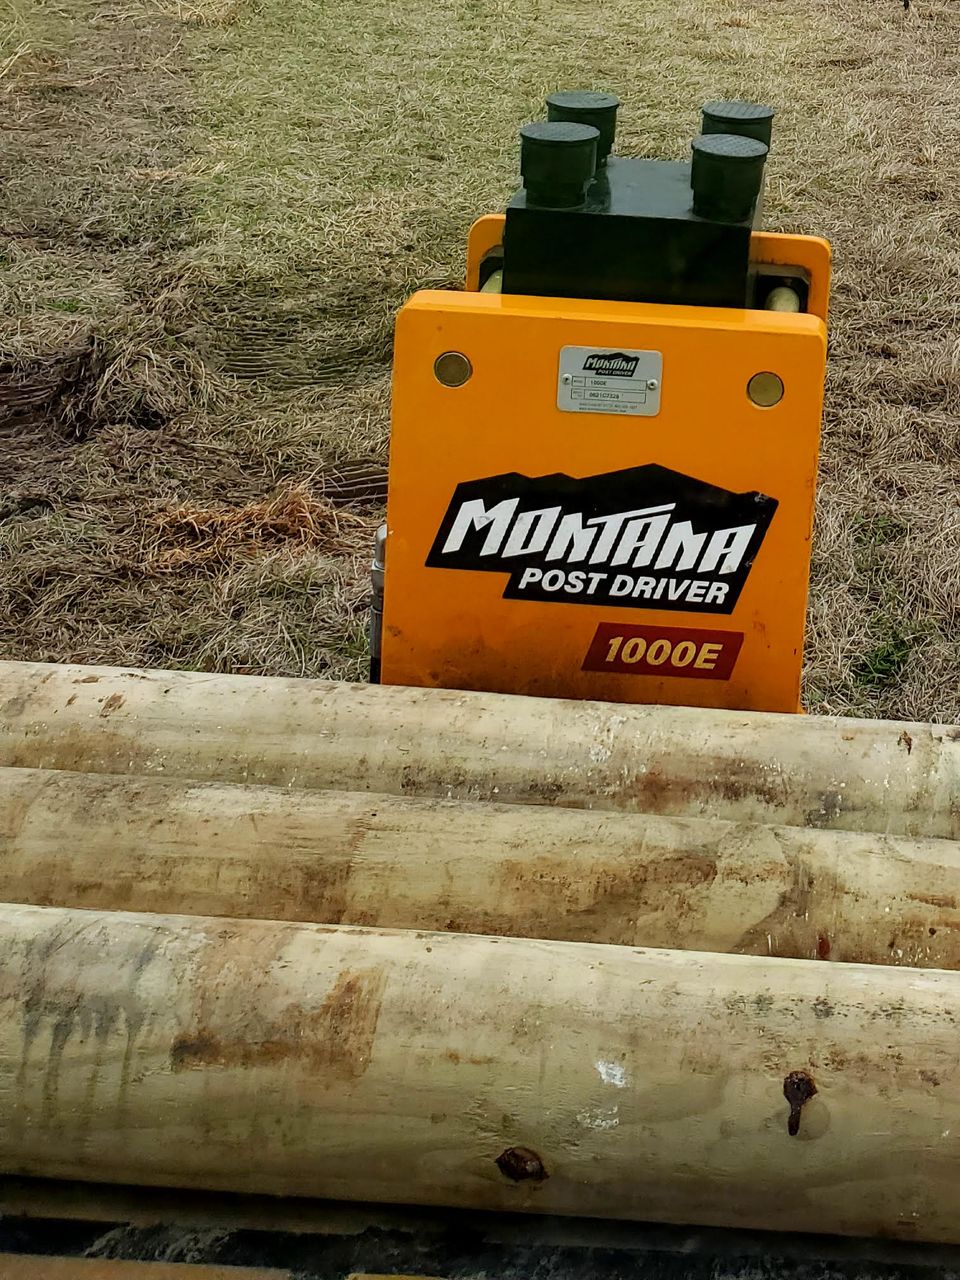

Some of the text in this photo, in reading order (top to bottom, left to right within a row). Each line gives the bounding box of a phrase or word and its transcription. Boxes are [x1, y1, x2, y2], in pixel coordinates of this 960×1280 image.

[585, 357, 636, 371] MONTANA
[442, 498, 757, 575] MONTANA
[518, 568, 730, 605] POST DRIVER
[605, 636, 724, 670] 1000E
